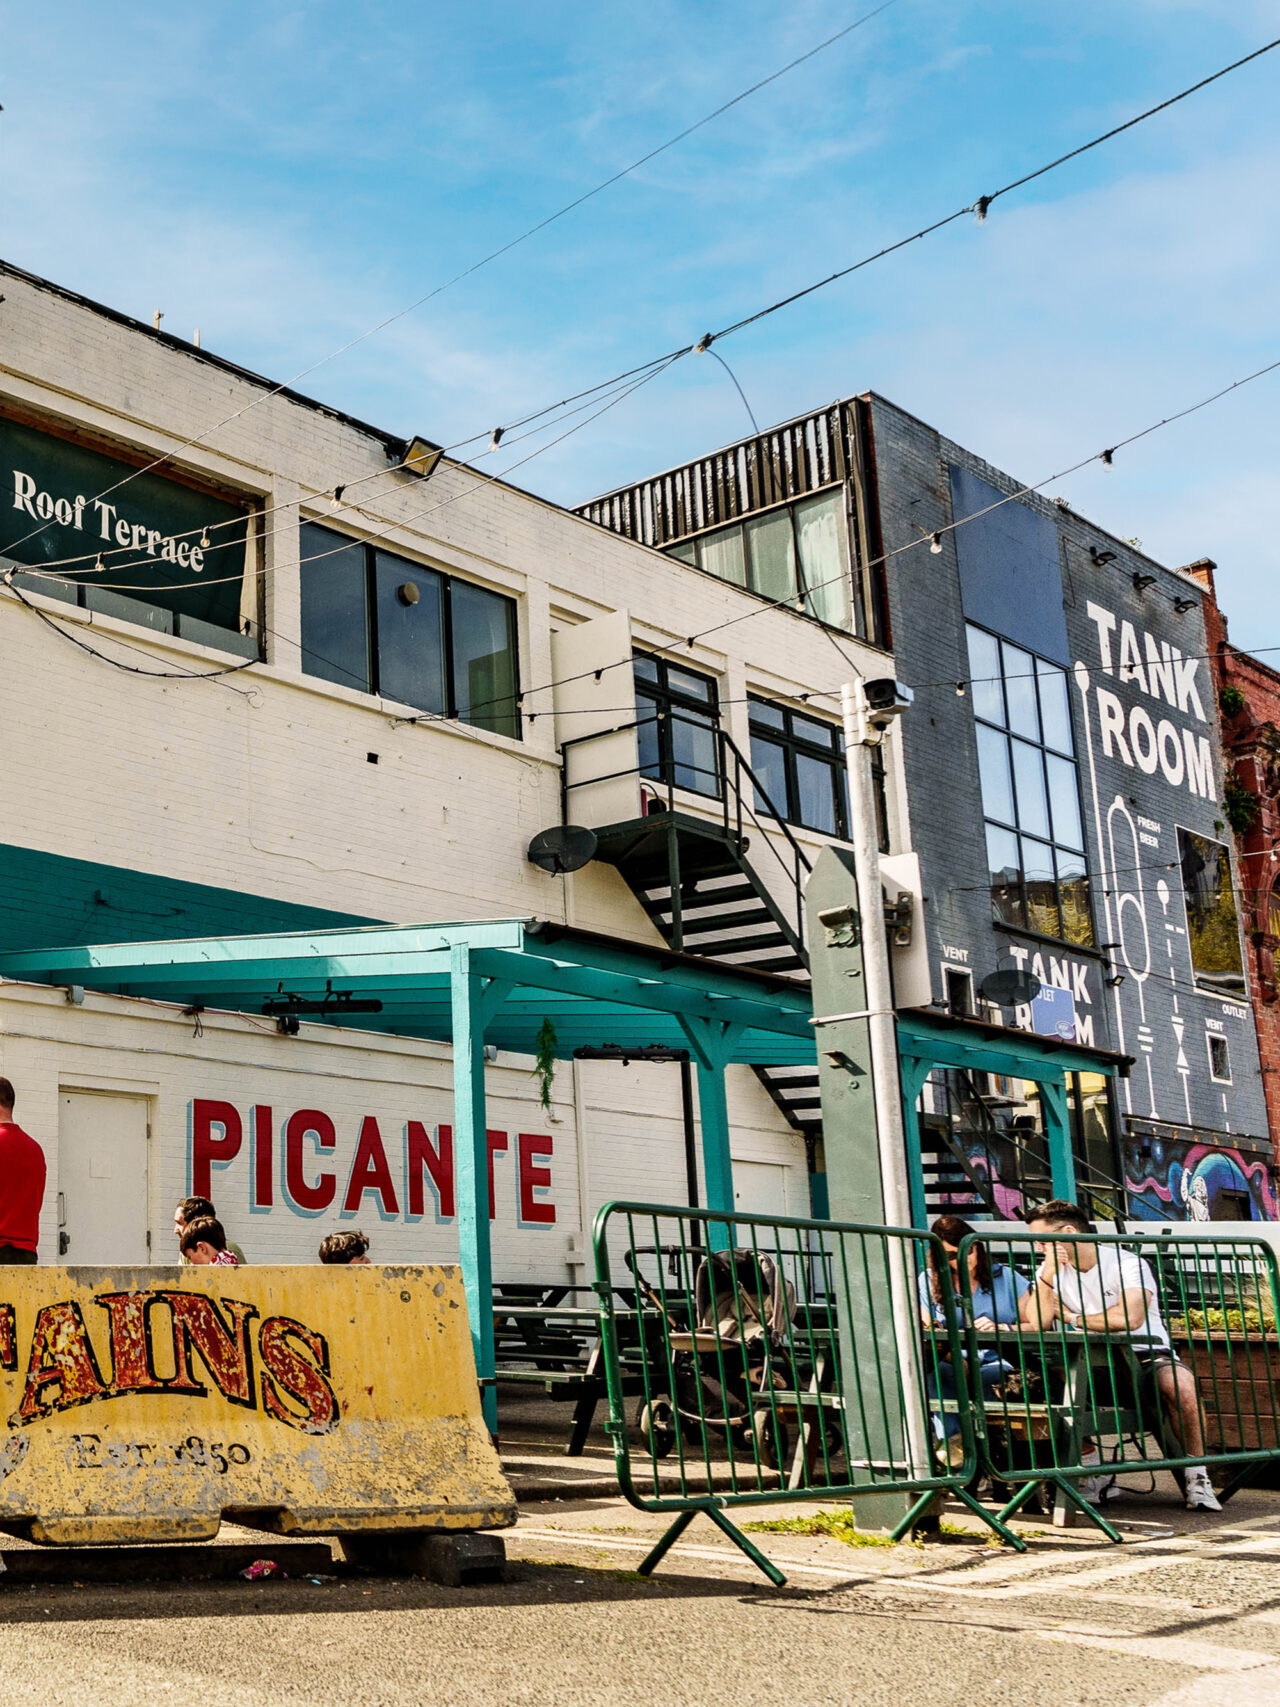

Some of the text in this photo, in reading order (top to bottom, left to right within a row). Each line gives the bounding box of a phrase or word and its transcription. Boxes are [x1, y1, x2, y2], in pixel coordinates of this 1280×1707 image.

[12, 469, 205, 573] Roof Terrace
[1086, 599, 1207, 723] TANK
[1096, 685, 1218, 802] ROOM
[1137, 815, 1161, 834] FRESH
[1139, 831, 1159, 849] BEER
[942, 944, 969, 963] VENT
[1009, 945, 1093, 1005] TANK
[1043, 988, 1056, 1003] LET
[1221, 1003, 1247, 1020] OUTLET
[1014, 1001, 1096, 1048] RM
[1204, 1017, 1224, 1032] VENT
